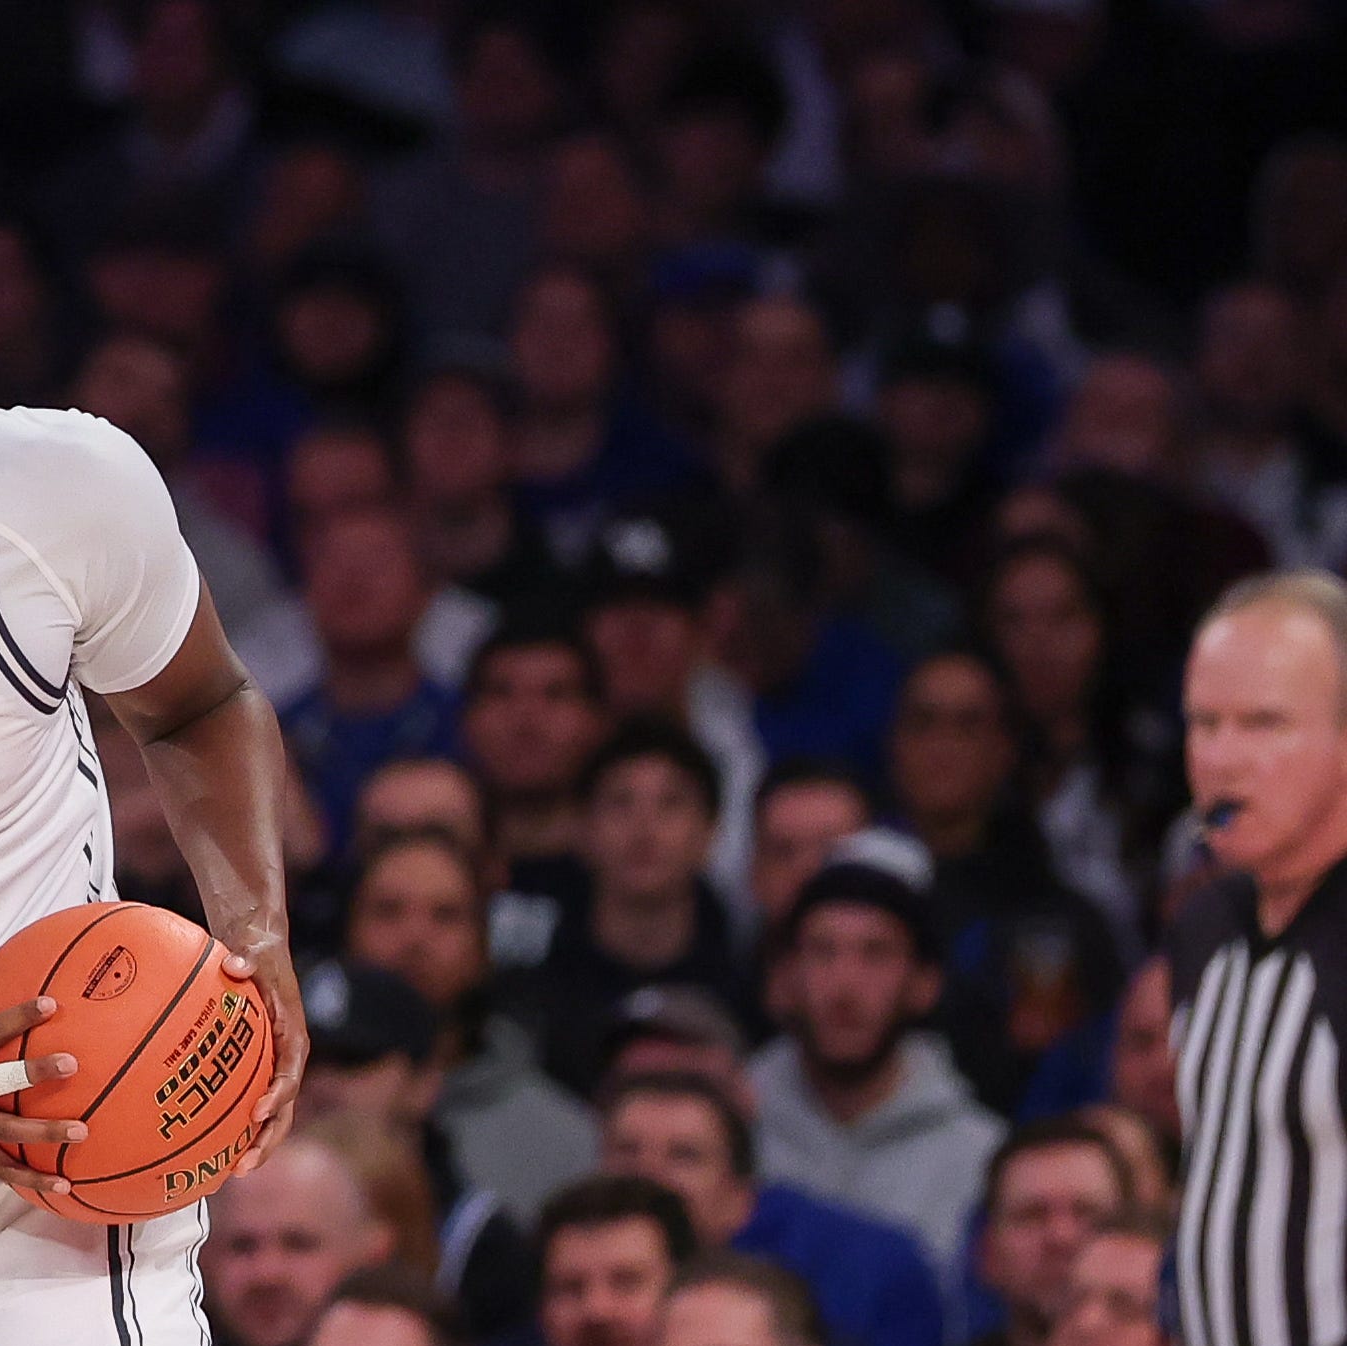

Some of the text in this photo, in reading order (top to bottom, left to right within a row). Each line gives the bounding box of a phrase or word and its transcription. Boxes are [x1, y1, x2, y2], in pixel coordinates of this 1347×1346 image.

[155, 1017, 227, 1107] 1000
[163, 1049, 182, 1069] BALL
[178, 1029, 198, 1048] GAME
[157, 994, 262, 1142] LEGACY
